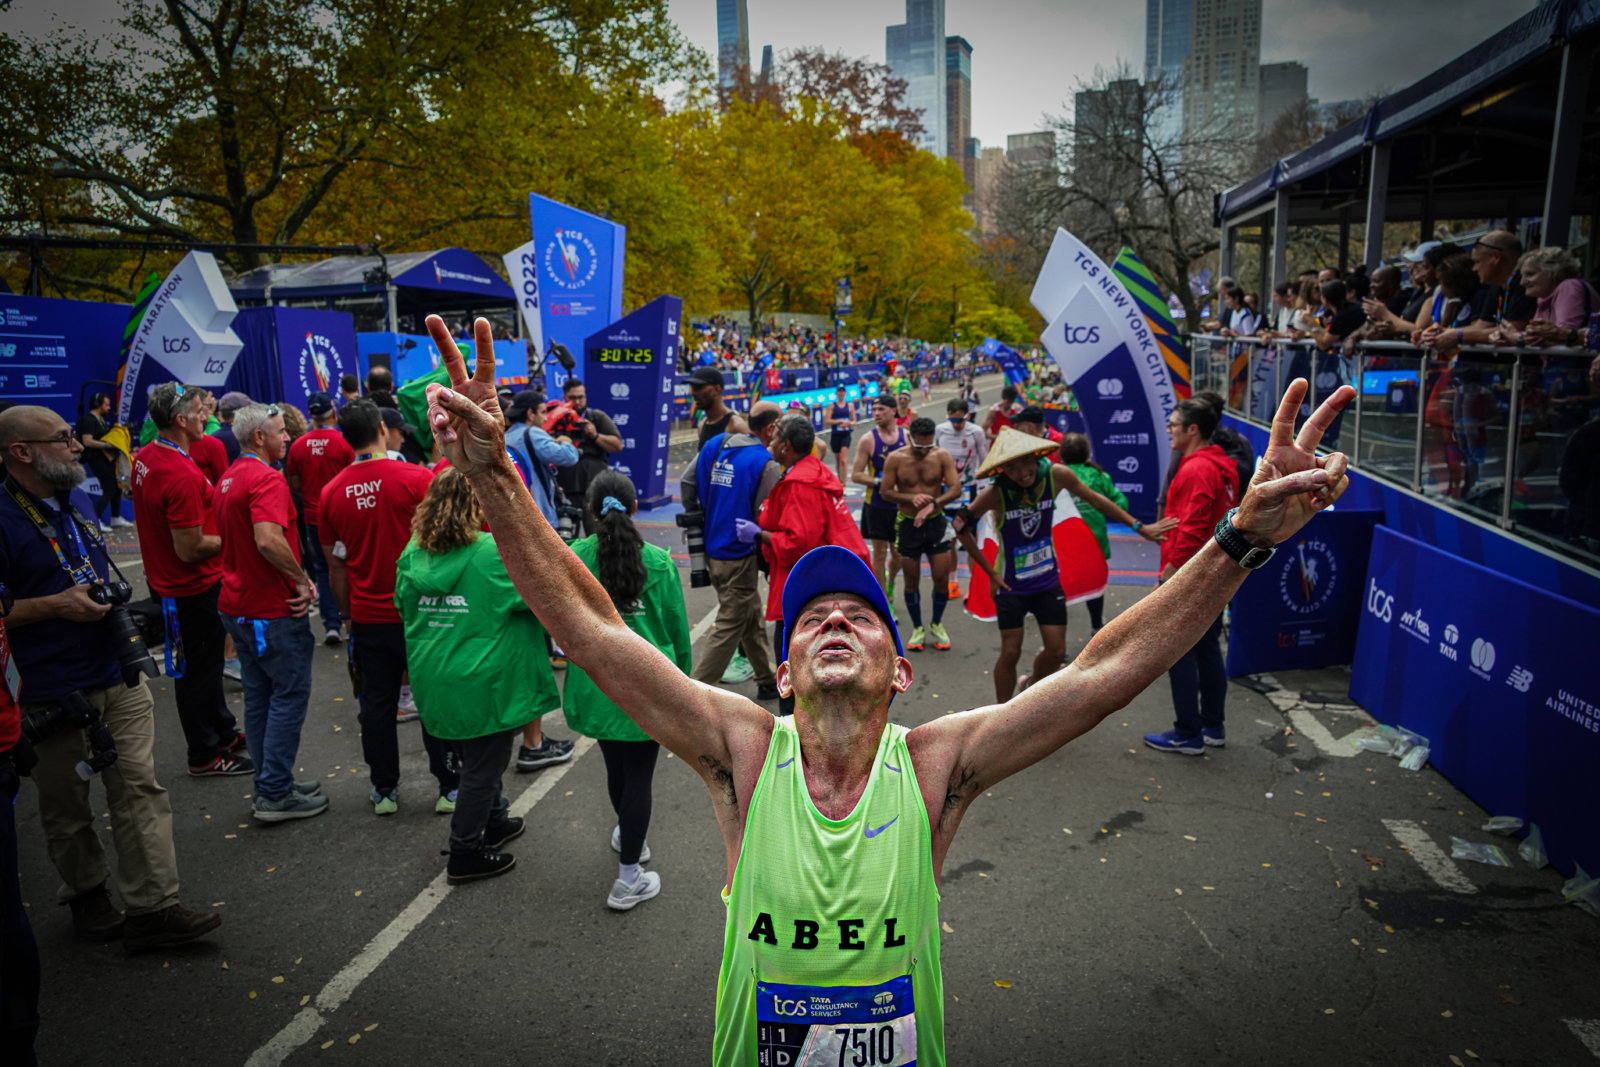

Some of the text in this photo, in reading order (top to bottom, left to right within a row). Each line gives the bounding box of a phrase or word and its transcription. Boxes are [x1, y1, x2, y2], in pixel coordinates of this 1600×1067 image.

[521, 253, 538, 309] 2022
[1074, 251, 1100, 277] TCS
[1098, 276, 1128, 308] NEW
[1125, 308, 1153, 351] YORK
[1146, 353, 1168, 388] CITY
[124, 366, 138, 399] YORK
[131, 336, 147, 365] CITY
[142, 274, 183, 336] MARATHON
[1064, 322, 1100, 344] tcs
[162, 336, 191, 354] tcs
[204, 357, 227, 374] tcs
[306, 438, 330, 448] FDNY
[311, 447, 324, 456] RC
[345, 479, 383, 499] FDNY
[356, 495, 377, 510] RC
[1368, 577, 1394, 623] tcs
[1439, 642, 1457, 661] TATA
[1558, 689, 1600, 719] UNITED
[1545, 696, 1599, 733] AIRLINES
[747, 912, 906, 950] ABEL
[773, 994, 807, 1016] tcs
[810, 996, 832, 1004] TATA
[810, 1002, 859, 1011] CONSULTANCY
[810, 1010, 842, 1018] SERVICES
[870, 1004, 896, 1016] TATA
[777, 1028, 786, 1043] 1
[835, 1025, 895, 1067] 7510
[776, 1050, 791, 1066] D
